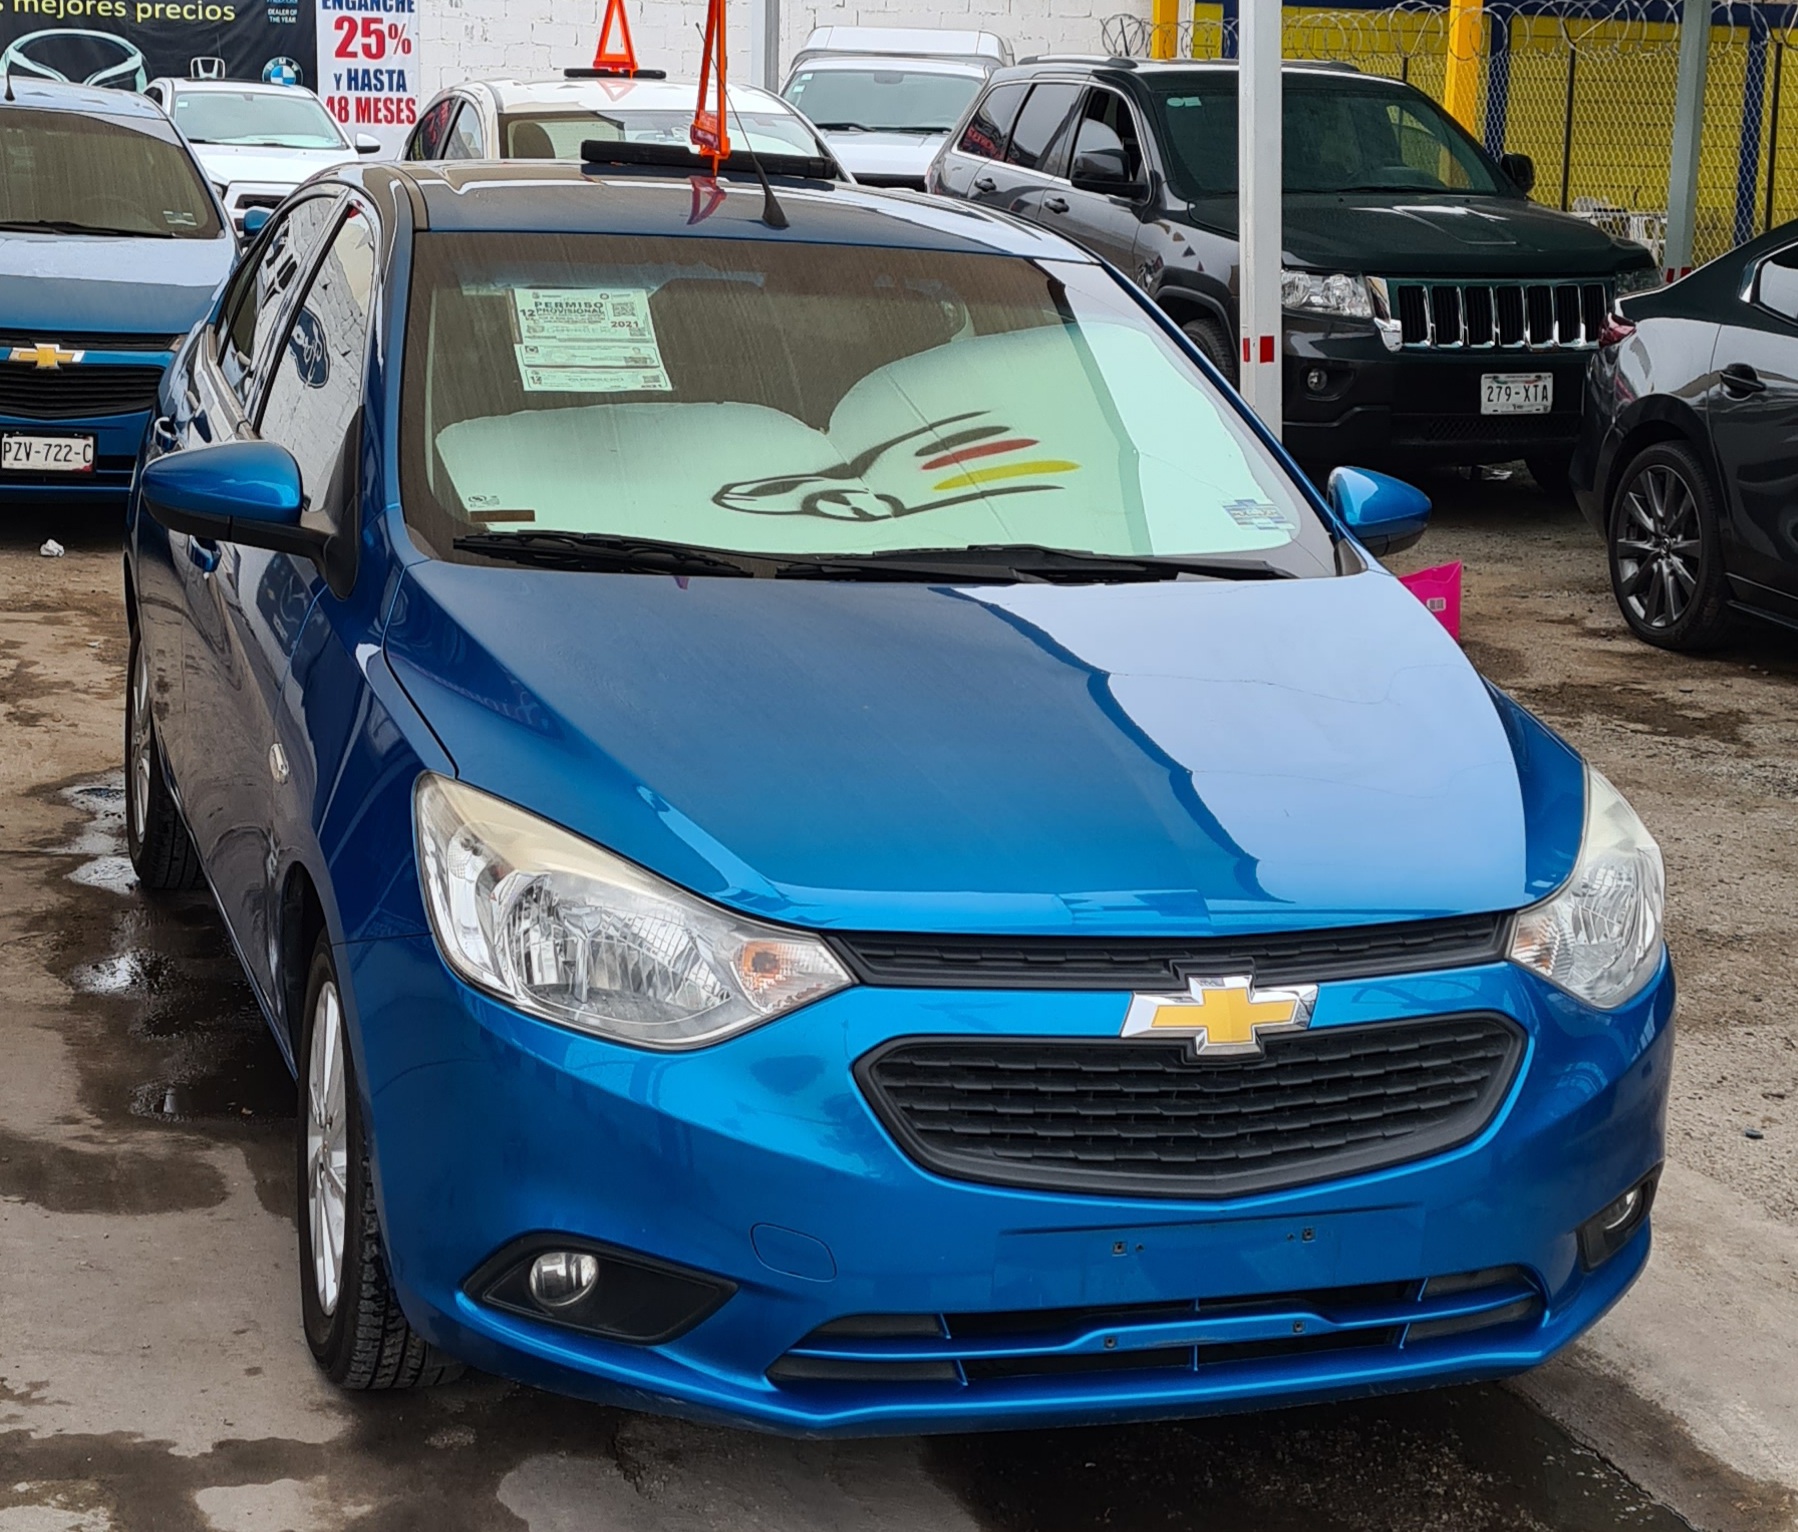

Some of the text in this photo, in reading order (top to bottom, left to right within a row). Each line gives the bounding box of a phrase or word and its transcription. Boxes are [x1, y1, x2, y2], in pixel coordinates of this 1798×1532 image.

[14, 0, 126, 19] mejores
[136, 0, 236, 23] precios
[334, 15, 412, 60] 25%
[333, 67, 407, 92] Y HASTA
[355, 96, 417, 124] MESES
[520, 309, 536, 318] 12
[1487, 384, 1549, 403] 279-XTA
[3, 441, 92, 464] PZV-722-C
